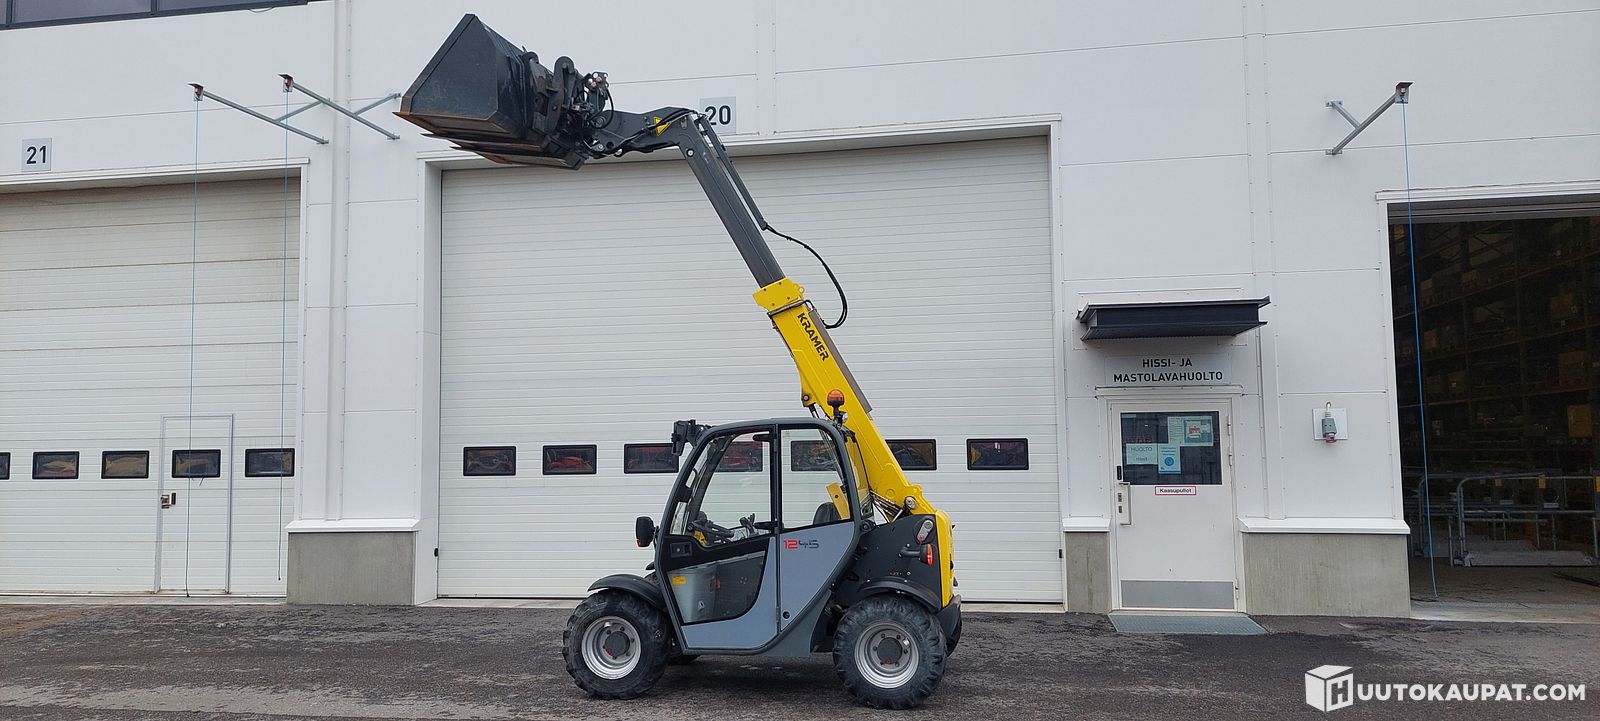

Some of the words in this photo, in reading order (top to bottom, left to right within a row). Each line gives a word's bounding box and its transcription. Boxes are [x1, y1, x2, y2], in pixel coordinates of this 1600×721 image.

[705, 105, 731, 125] 20
[26, 145, 47, 164] 21
[797, 312, 829, 362] KRAMER
[1142, 359, 1176, 368] HISSI-
[1179, 358, 1193, 367] JA
[1113, 371, 1223, 383] MASTOLAVAHUOLTO
[783, 539, 820, 549] 1245
